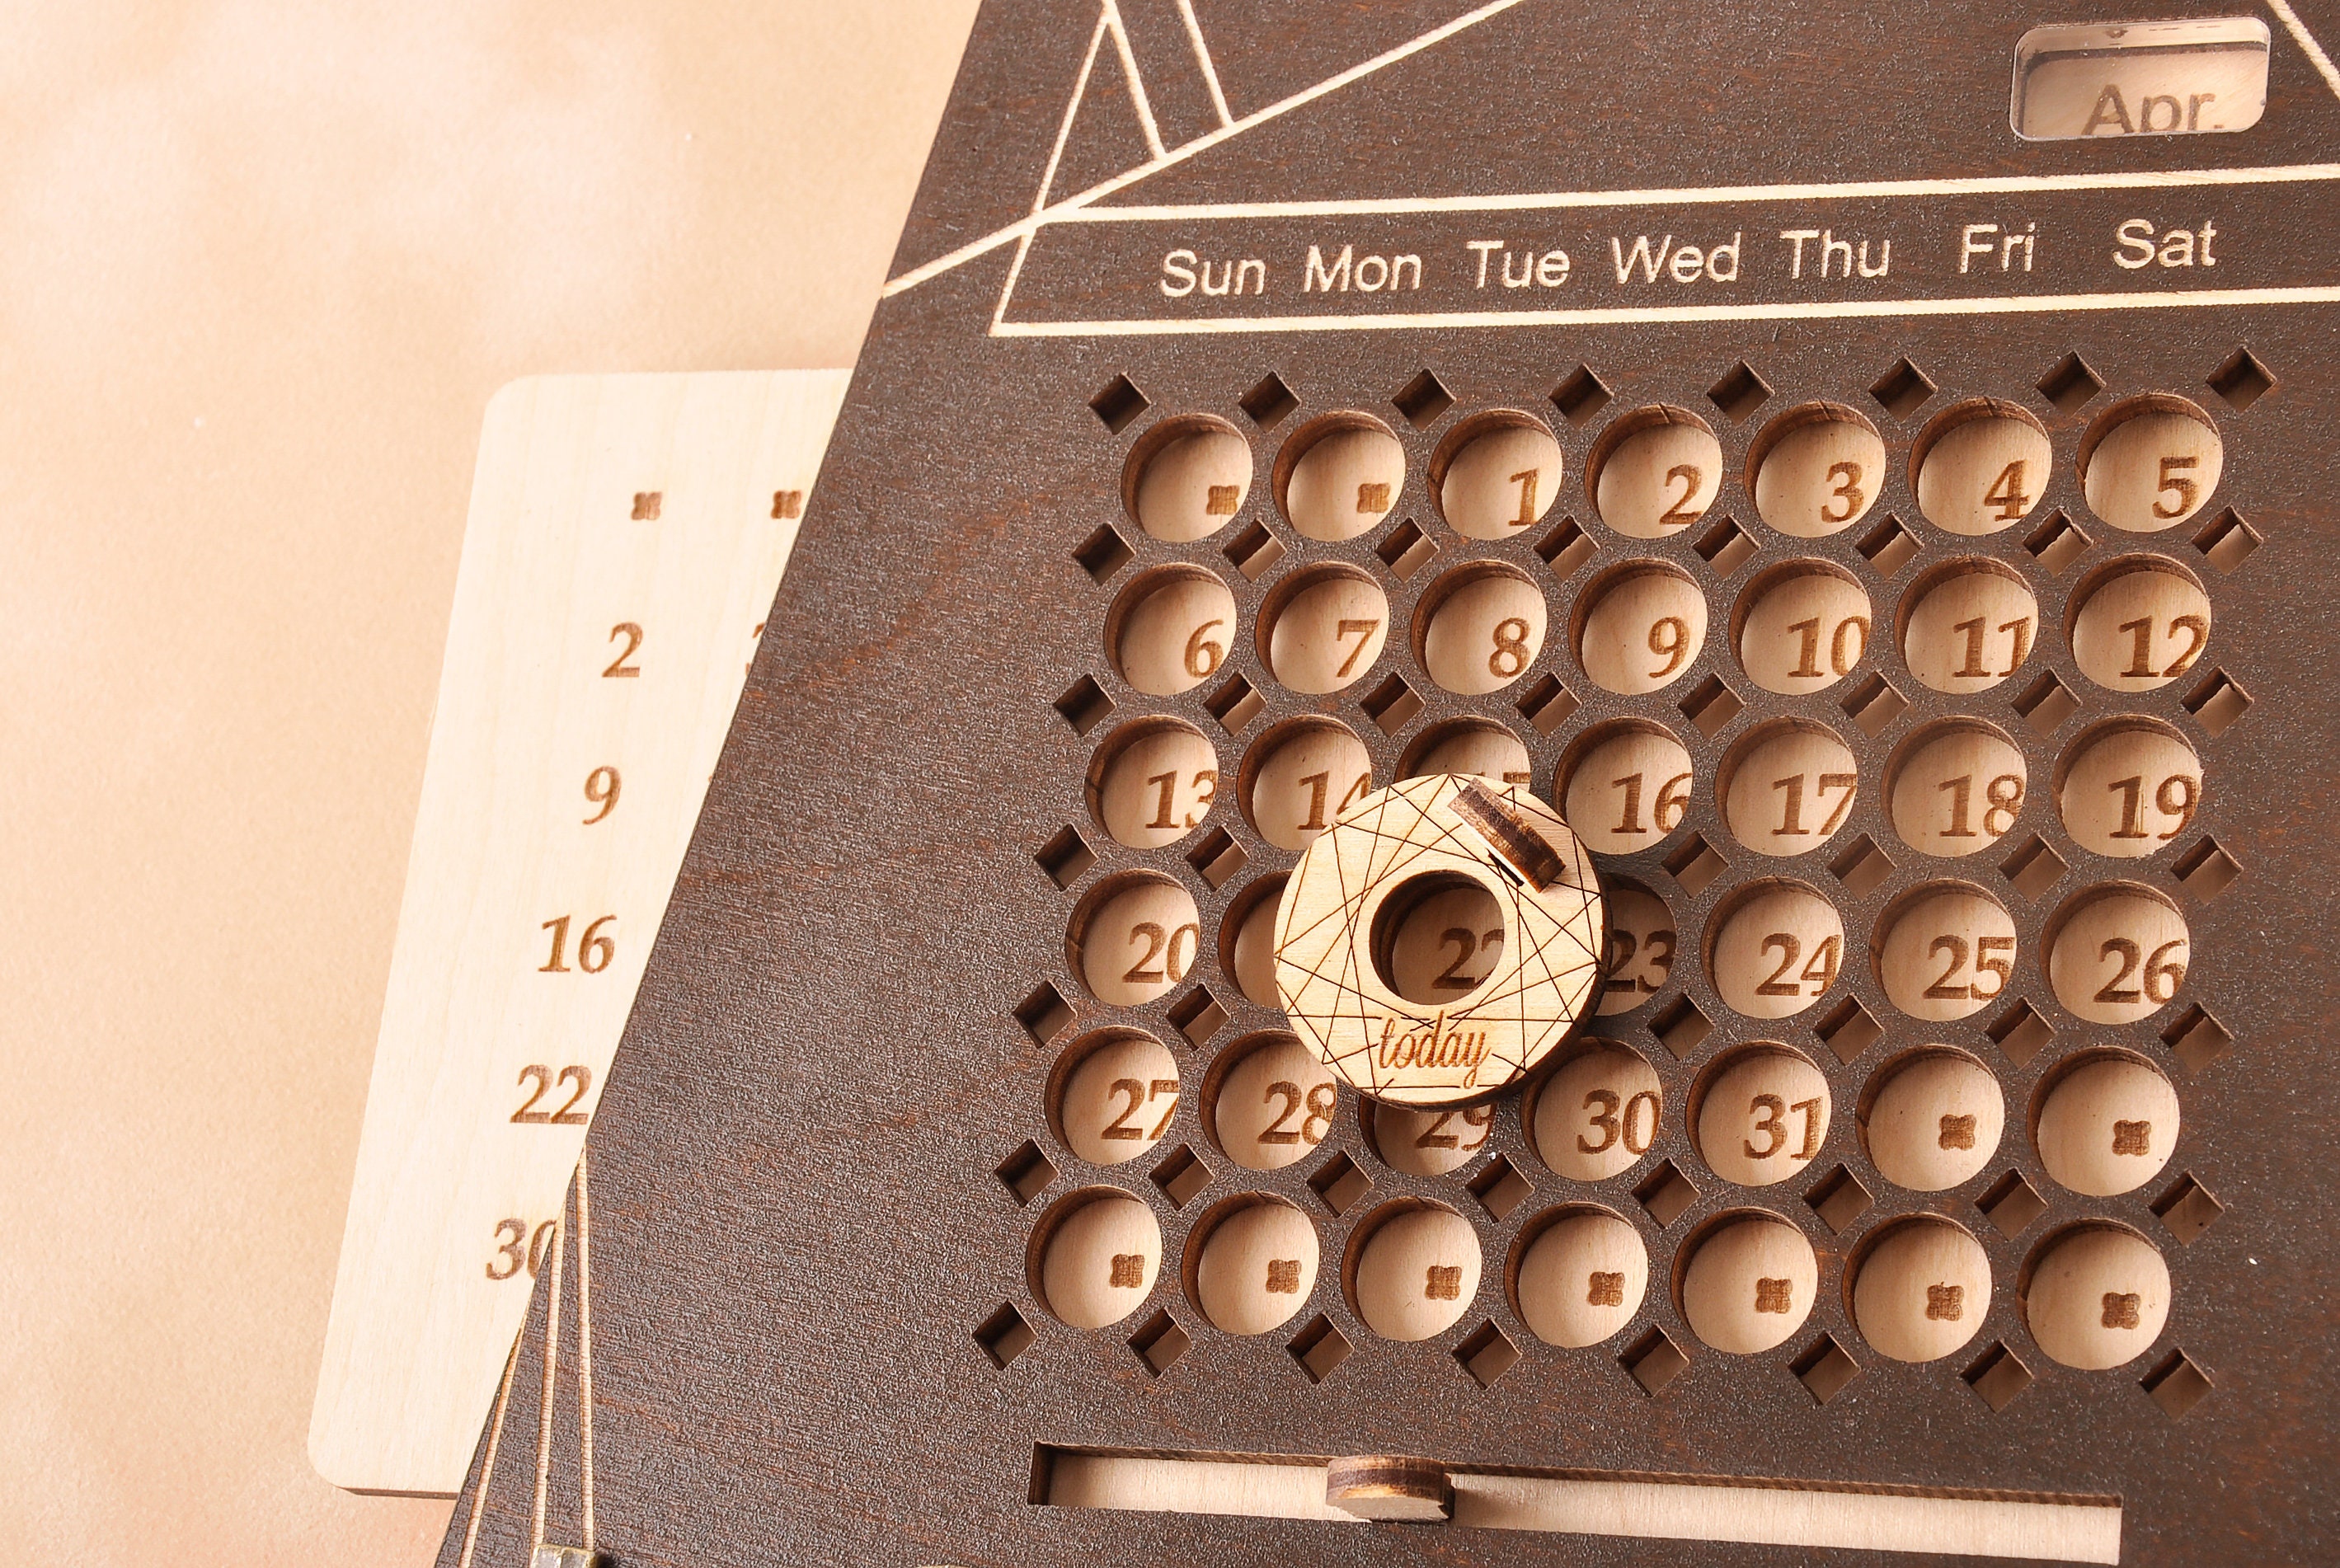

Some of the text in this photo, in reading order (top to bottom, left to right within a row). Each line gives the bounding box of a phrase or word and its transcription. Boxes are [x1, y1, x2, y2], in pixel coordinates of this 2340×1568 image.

[1159, 217, 2218, 298] Sun Mon Tue Wed Thu Fri Sat
[1507, 455, 2200, 528] 1 2 3 4 5
[601, 621, 644, 678] 2
[1183, 614, 2207, 680] 6 7 8 9 10 11 12
[582, 766, 622, 826] 9
[1144, 768, 1218, 830] 13
[1610, 771, 1692, 835] 16
[1771, 772, 1858, 836] 17
[1938, 773, 2026, 838] 18
[2107, 773, 2200, 841] 19
[538, 914, 617, 974] 16
[1121, 922, 1201, 984] 20
[1604, 927, 1675, 991] 23
[1756, 932, 1843, 998] 24
[1922, 935, 2016, 1002] 25
[2093, 937, 2187, 1005] 26
[1377, 1010, 1491, 1091] today
[510, 1064, 592, 1124] 22
[1100, 1078, 1180, 1143] 27
[1257, 1080, 1337, 1146] 28
[1576, 1089, 1662, 1155] 30
[1742, 1093, 1824, 1162] 31
